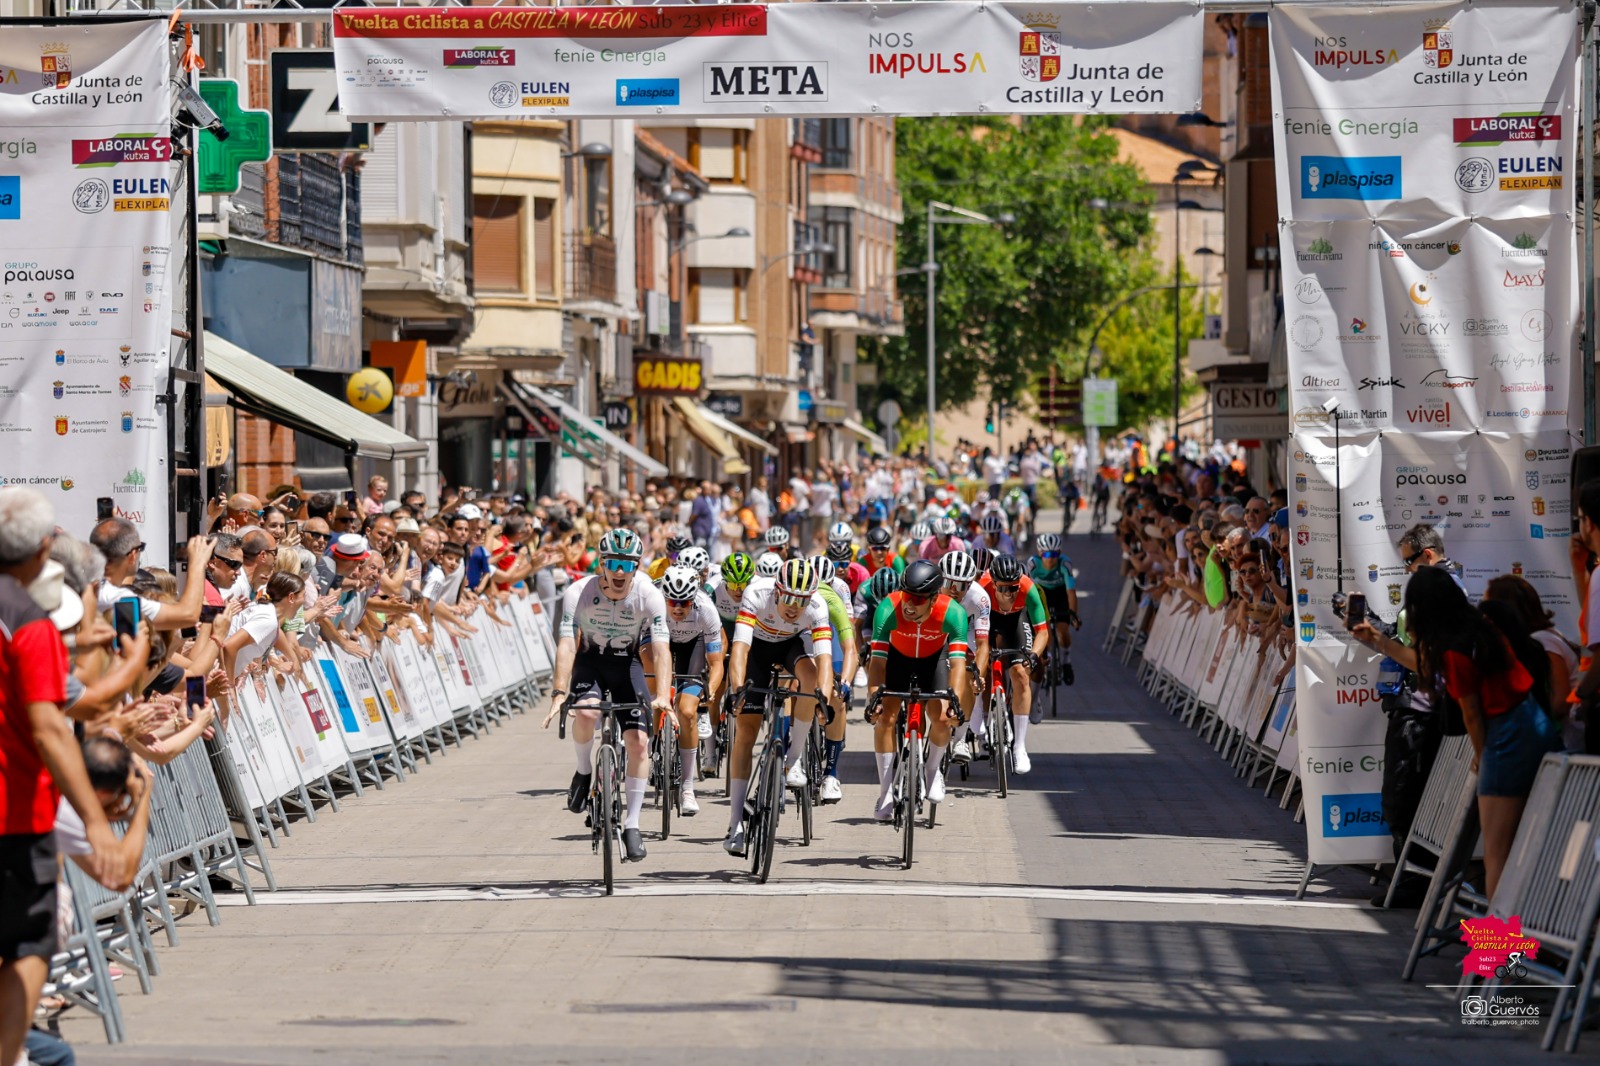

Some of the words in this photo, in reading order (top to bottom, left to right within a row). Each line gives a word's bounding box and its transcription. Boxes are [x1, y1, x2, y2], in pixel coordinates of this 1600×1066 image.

[342, 14, 399, 30] Vuelta
[404, 14, 470, 30] Ciclista
[474, 18, 484, 29] a
[488, 11, 568, 30] CASTILLA
[574, 12, 586, 29] Y
[589, 10, 638, 30] LEÓN
[639, 14, 672, 29] Sub
[707, 17, 718, 32] y
[722, 8, 758, 28] Élite
[869, 33, 914, 48] NOS
[1314, 36, 1347, 48] NOS
[454, 50, 498, 58] LABORAL
[1314, 49, 1400, 69] IMPULSA
[1457, 54, 1502, 67] Junta
[1508, 53, 1528, 65] de
[368, 58, 404, 66] palausa
[869, 52, 987, 79] IMPULSA
[1067, 64, 1130, 80] Junta
[1136, 63, 1164, 80] de
[1414, 71, 1470, 84] Castilla
[1474, 73, 1484, 86] y
[1489, 69, 1528, 82] León
[76, 76, 121, 88] Junta
[125, 75, 143, 87] de
[710, 66, 824, 96] META
[522, 82, 570, 94] EULEN
[629, 88, 674, 100] plaspisa
[32, 92, 88, 106] Castilla
[92, 94, 102, 108] y
[106, 91, 143, 105] León
[522, 96, 569, 106] FLEXIPLÁN
[1006, 86, 1084, 103] Castilla
[1090, 90, 1103, 108] y
[1110, 86, 1164, 103] León
[1470, 118, 1536, 131] LABORAL
[1509, 131, 1536, 140] kutxa
[89, 140, 150, 153] LABORAL
[123, 152, 150, 160] kutxa
[1498, 156, 1563, 173] EULEN
[1322, 170, 1394, 190] plaspisa
[1500, 176, 1562, 188] FLEXIPLÁN
[1415, 242, 1445, 250] cáncer
[5, 269, 74, 284] palausa
[64, 291, 76, 301] FIAT
[637, 362, 701, 390] GADIS
[1358, 377, 1405, 390] Spiuk
[608, 408, 628, 425] IN
[29, 476, 59, 485] cáncer
[1396, 474, 1466, 488] palausa
[1458, 495, 1468, 504] FIAT
[1337, 674, 1368, 687] NOS
